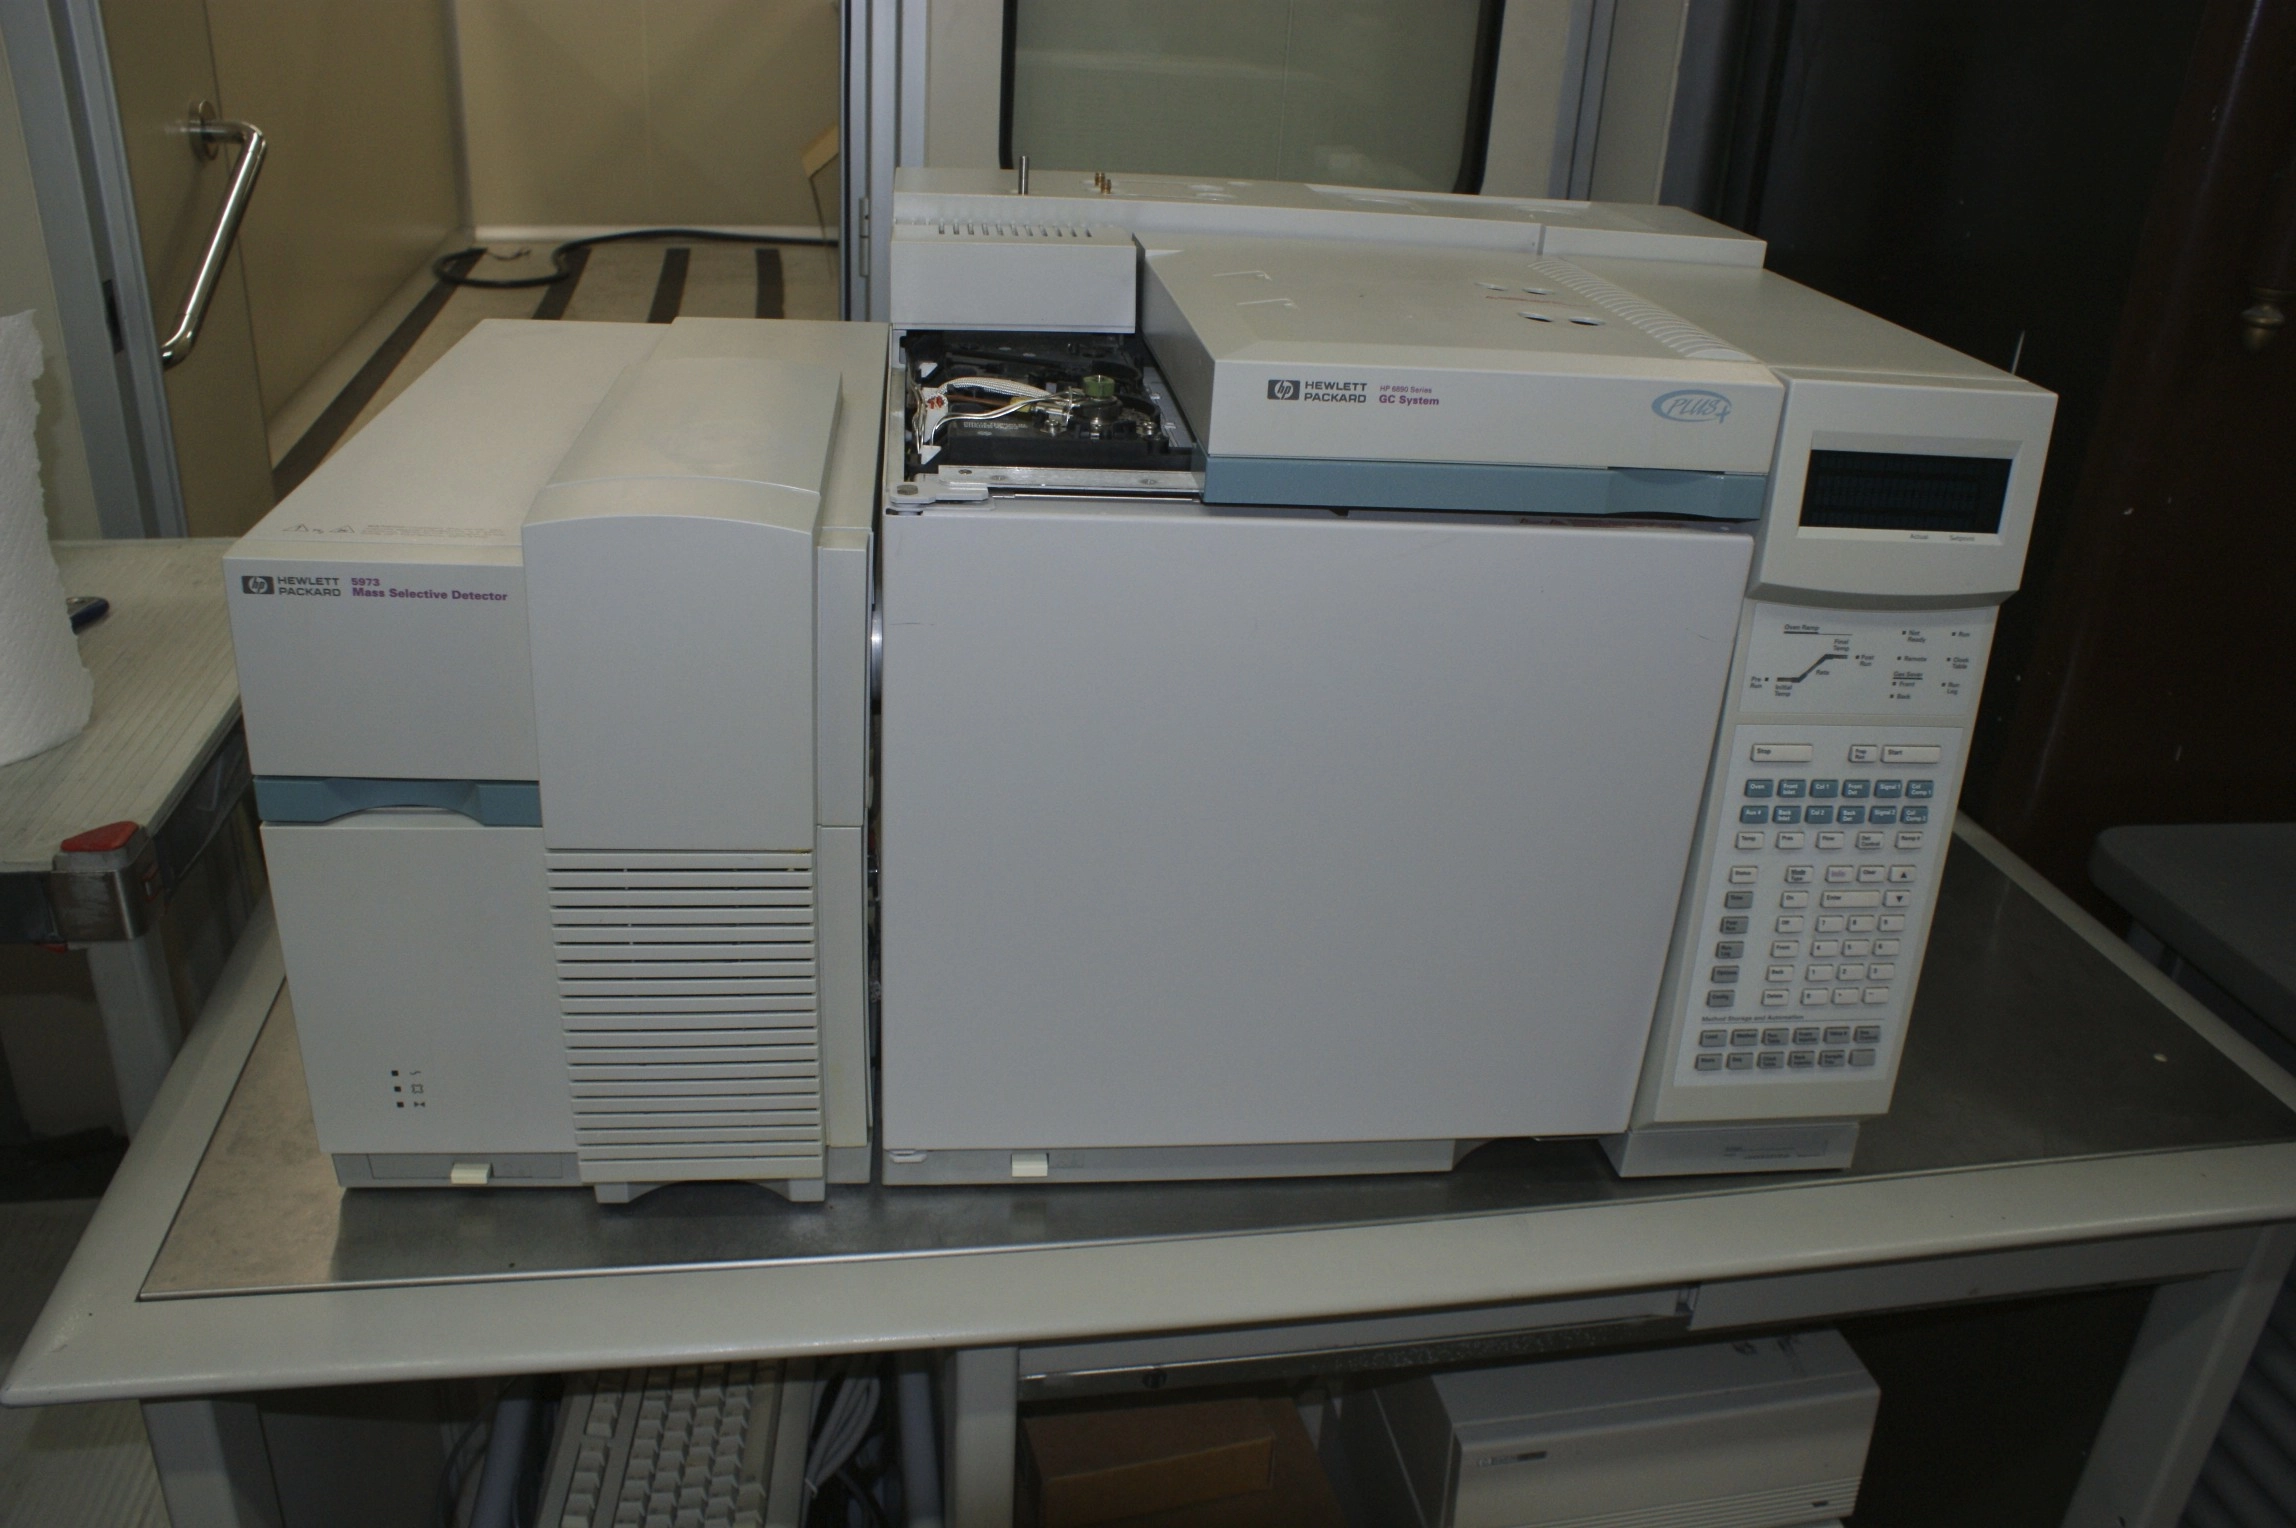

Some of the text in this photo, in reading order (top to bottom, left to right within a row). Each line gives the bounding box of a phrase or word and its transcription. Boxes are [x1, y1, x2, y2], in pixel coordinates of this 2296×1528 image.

[1305, 381, 1367, 391] HEWLETT
[1304, 392, 1366, 403] PACKARD
[1379, 394, 1439, 406] GC System
[277, 576, 339, 586] HEWLETT
[351, 578, 380, 586] 5973
[279, 587, 341, 597] PACKARD
[352, 588, 507, 600] Mass Selective Detector
